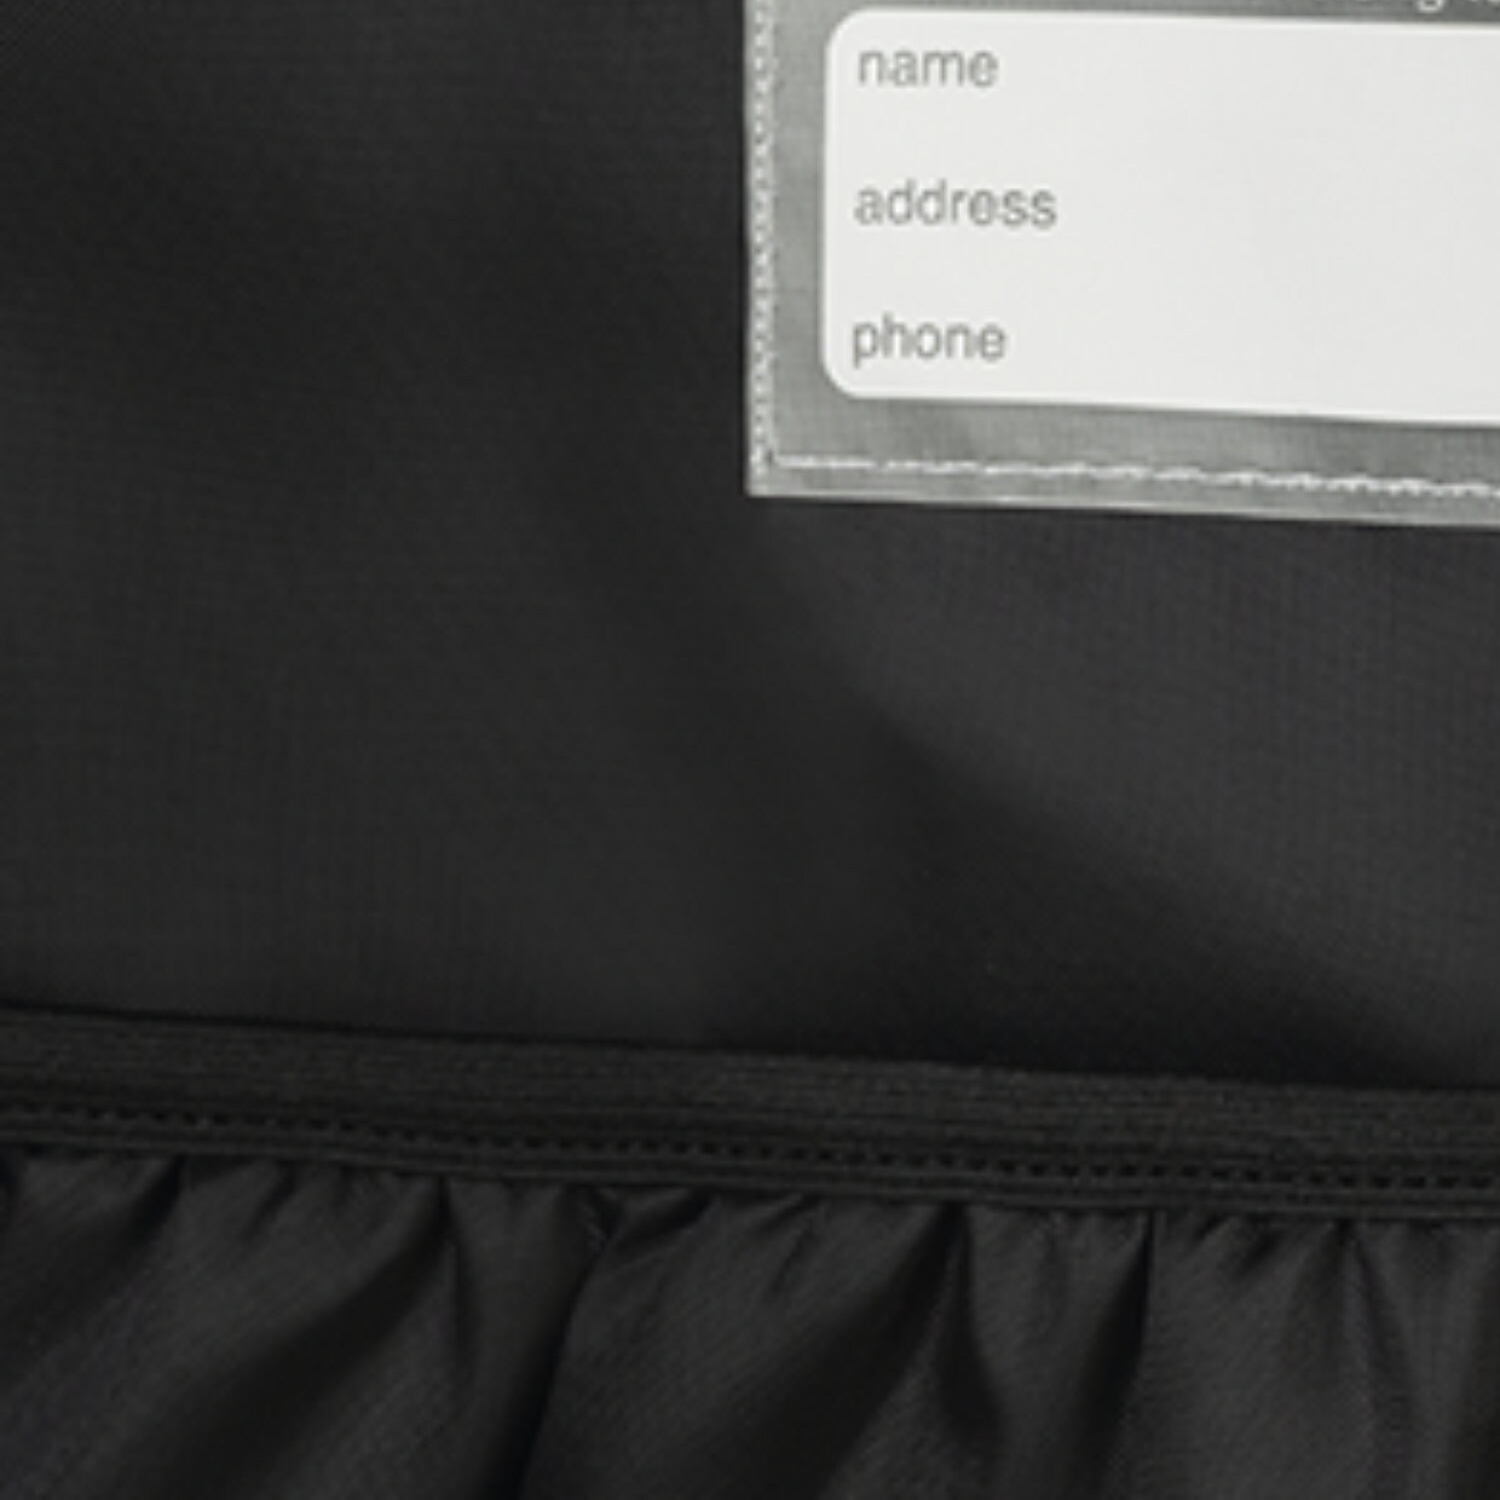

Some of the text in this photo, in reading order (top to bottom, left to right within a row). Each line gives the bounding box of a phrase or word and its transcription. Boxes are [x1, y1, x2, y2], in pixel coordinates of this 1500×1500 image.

[858, 48, 999, 90] name
[853, 178, 1058, 231] address
[851, 313, 1007, 370] phone
